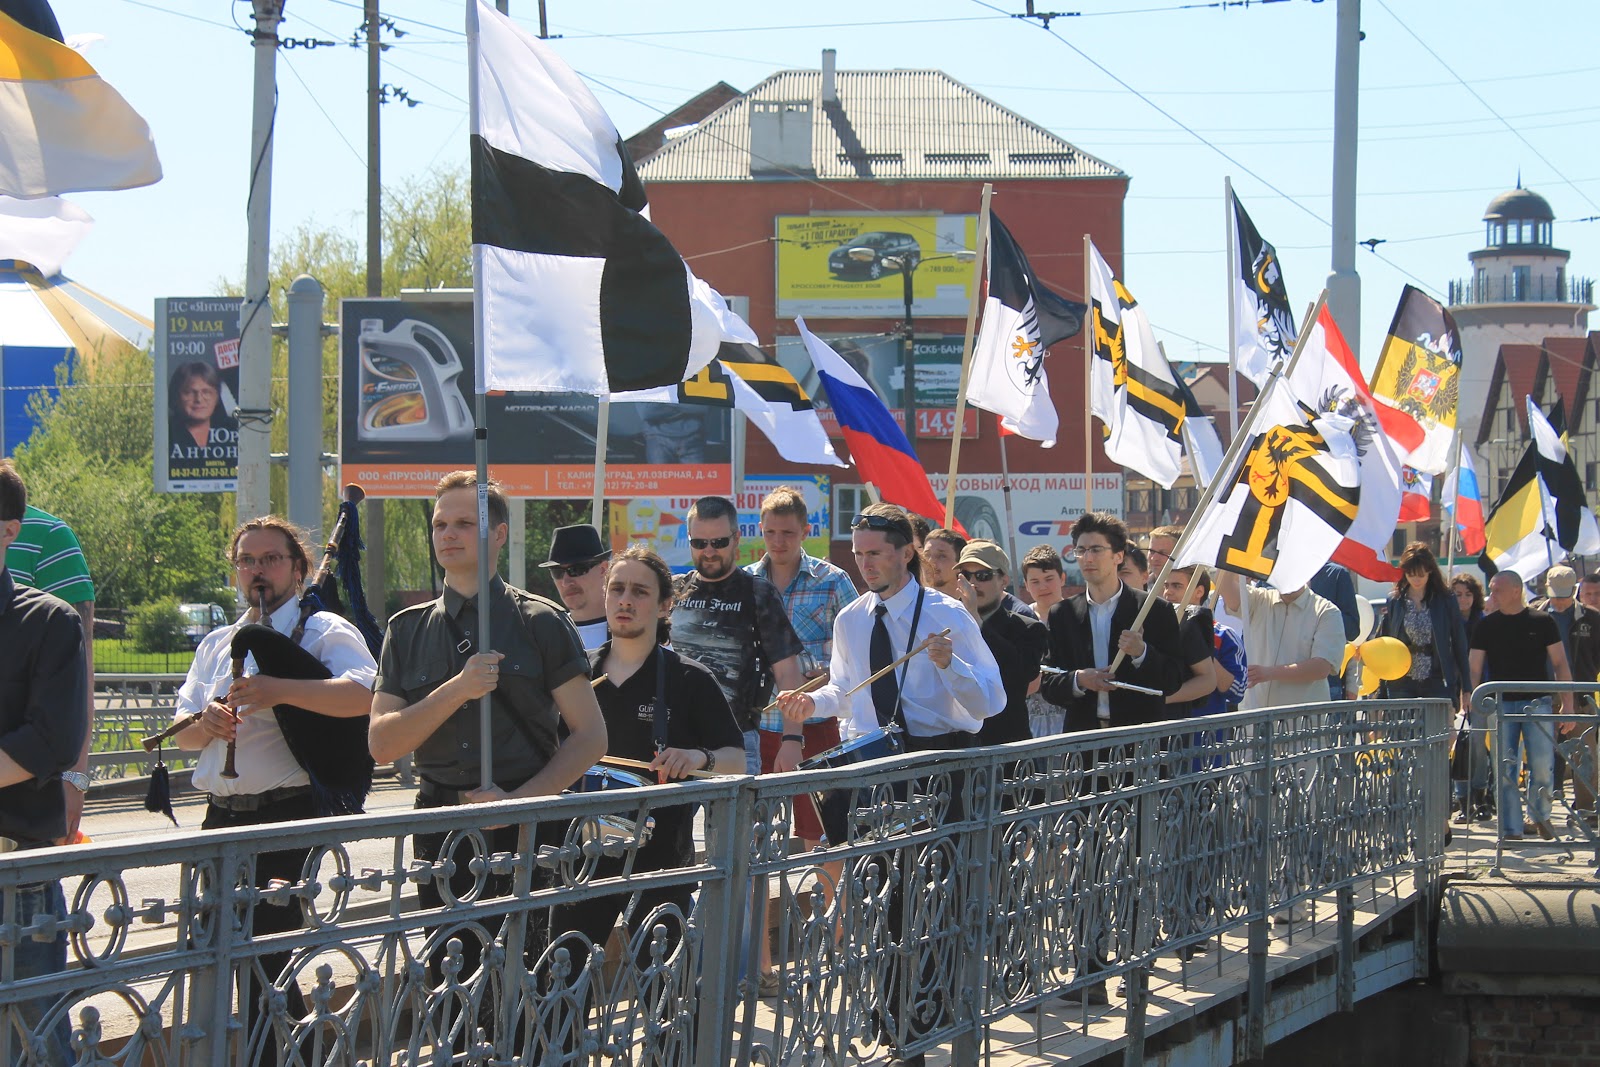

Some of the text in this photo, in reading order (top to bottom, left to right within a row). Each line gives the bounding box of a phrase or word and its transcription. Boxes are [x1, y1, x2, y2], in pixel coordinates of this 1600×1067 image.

[811, 231, 824, 240] ГОД
[825, 228, 859, 239] ГАРАНТИИ
[168, 302, 188, 314] ДС
[170, 317, 224, 332] 19 МАЯ
[170, 341, 206, 355] 19:00
[358, 471, 380, 480] ООО
[707, 471, 718, 479] 43
[1010, 478, 1041, 493] ХОД
[709, 598, 742, 613] Front
